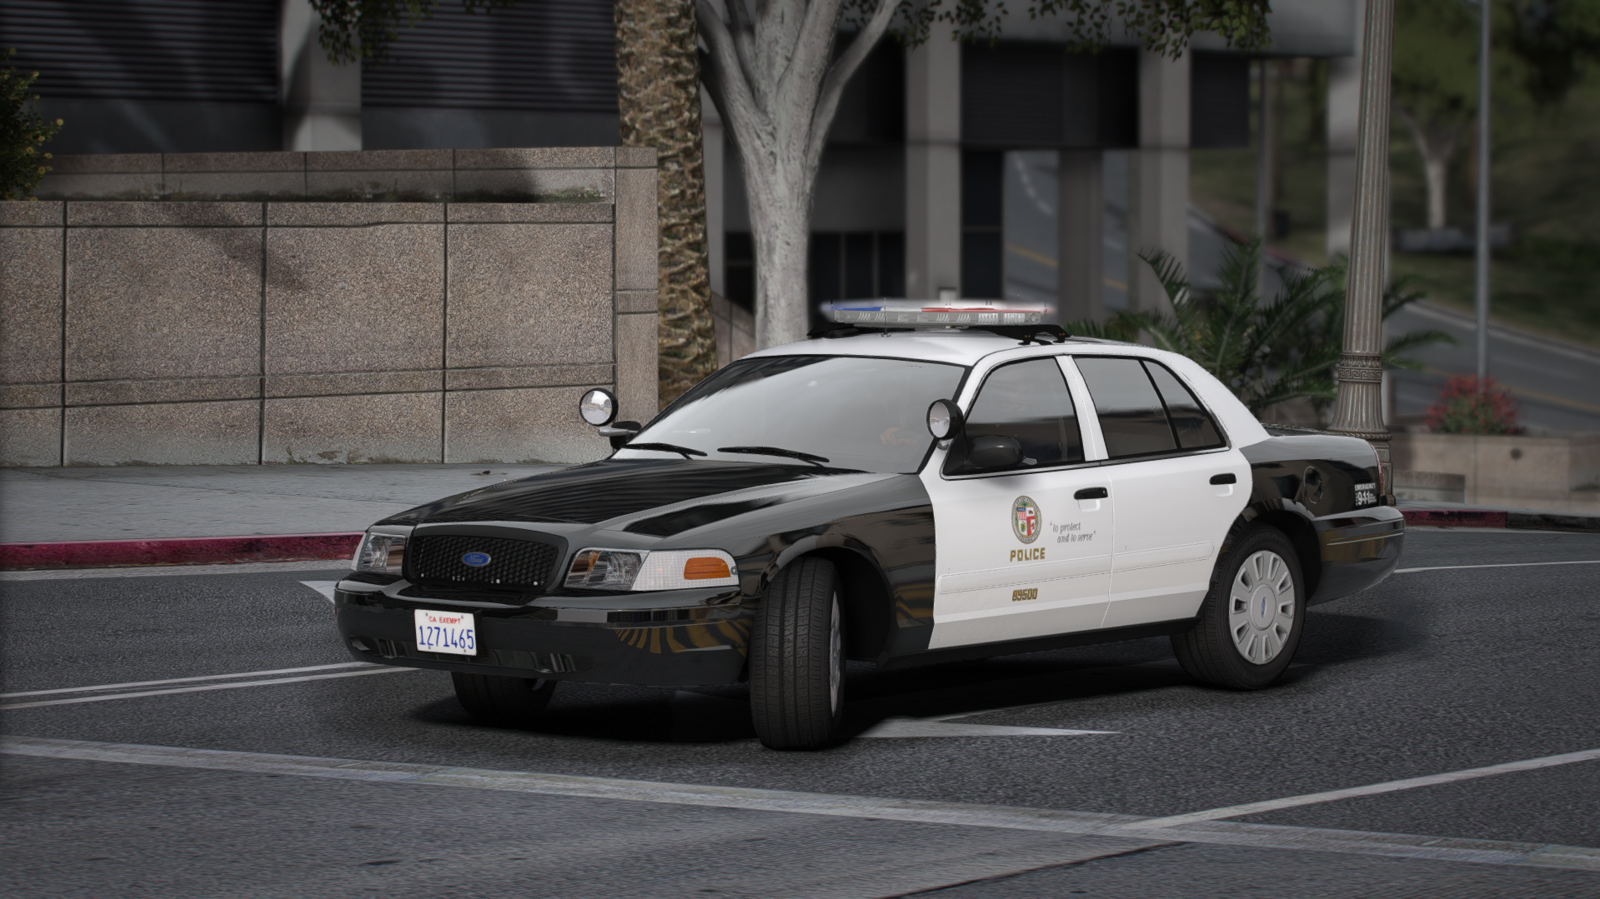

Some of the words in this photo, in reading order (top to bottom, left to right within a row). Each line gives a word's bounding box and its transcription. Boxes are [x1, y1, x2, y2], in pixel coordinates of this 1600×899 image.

[1060, 522, 1081, 534] protect
[1057, 533, 1070, 543] and
[1010, 547, 1046, 562] POLICE
[419, 625, 474, 649] 1271465
